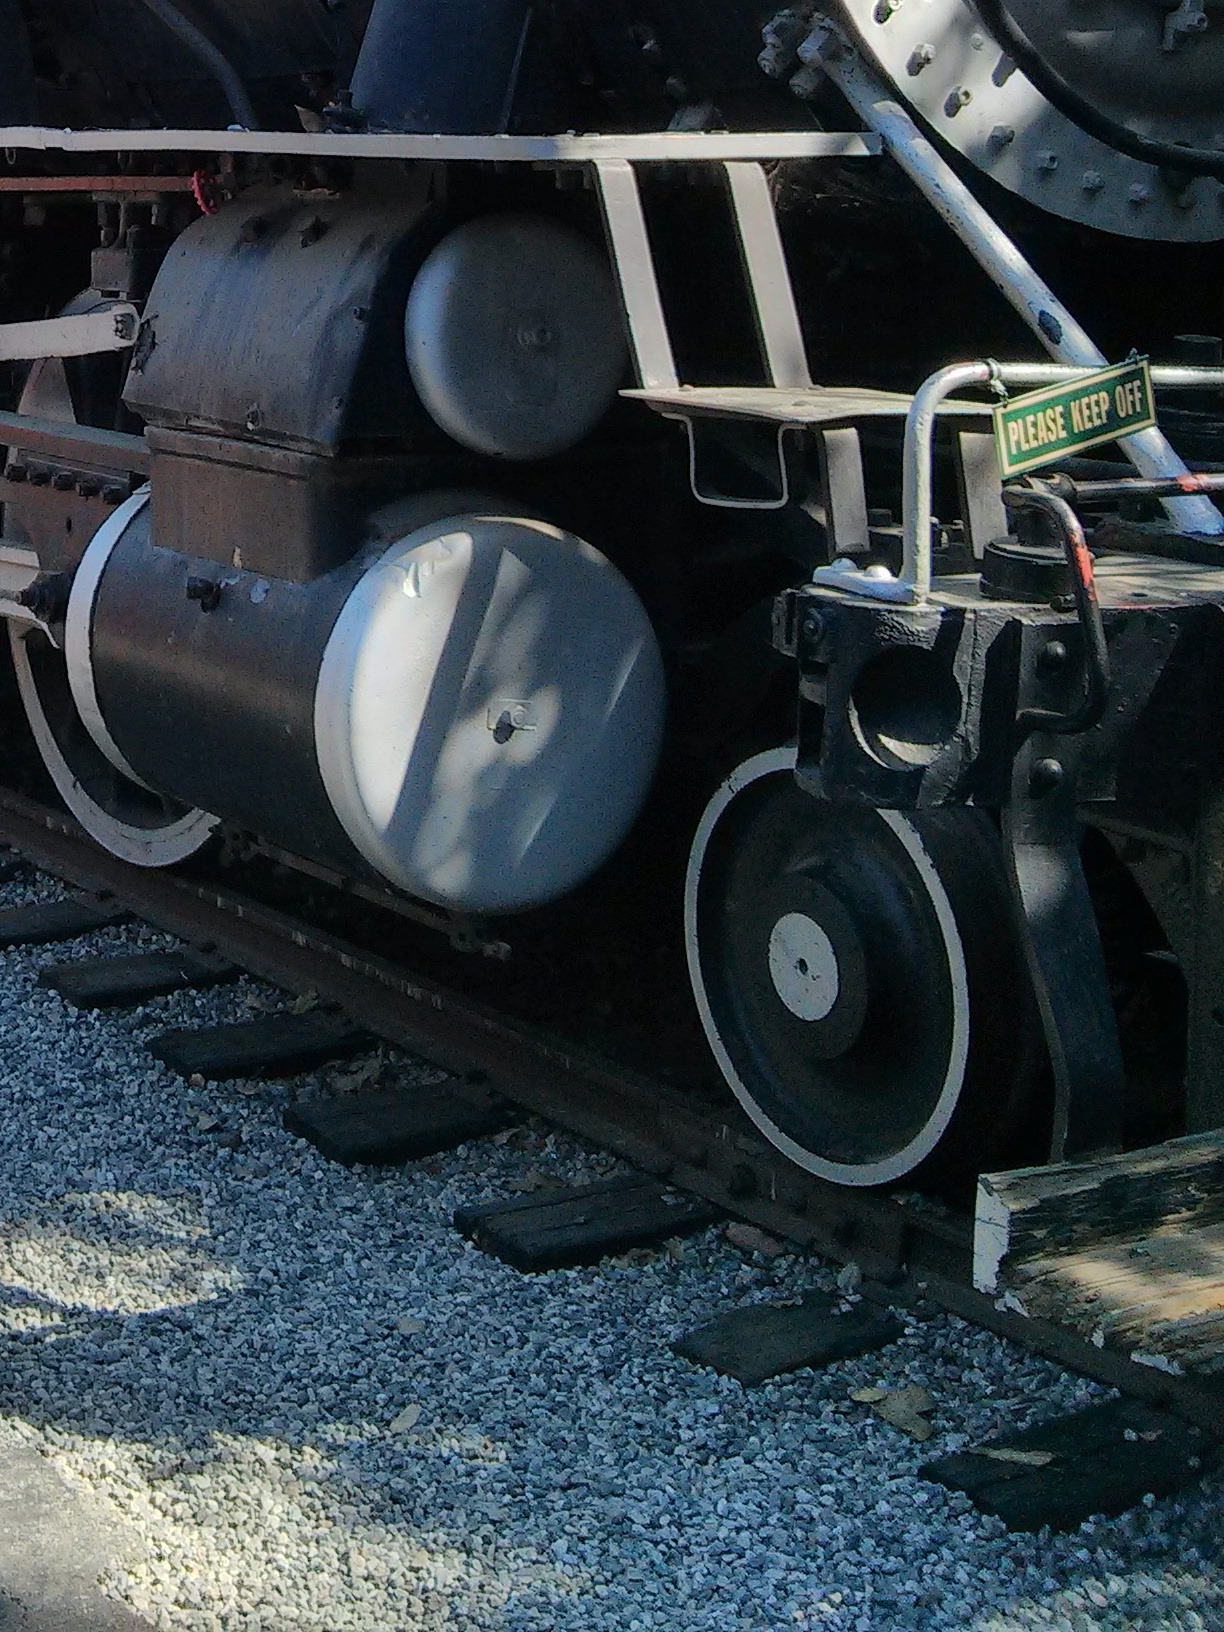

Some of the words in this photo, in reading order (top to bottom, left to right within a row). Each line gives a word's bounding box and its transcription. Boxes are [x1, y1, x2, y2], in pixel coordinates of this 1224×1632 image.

[1007, 405, 1068, 455] PLEASE
[1070, 391, 1110, 434] KEEP
[1114, 379, 1143, 419] OFF
